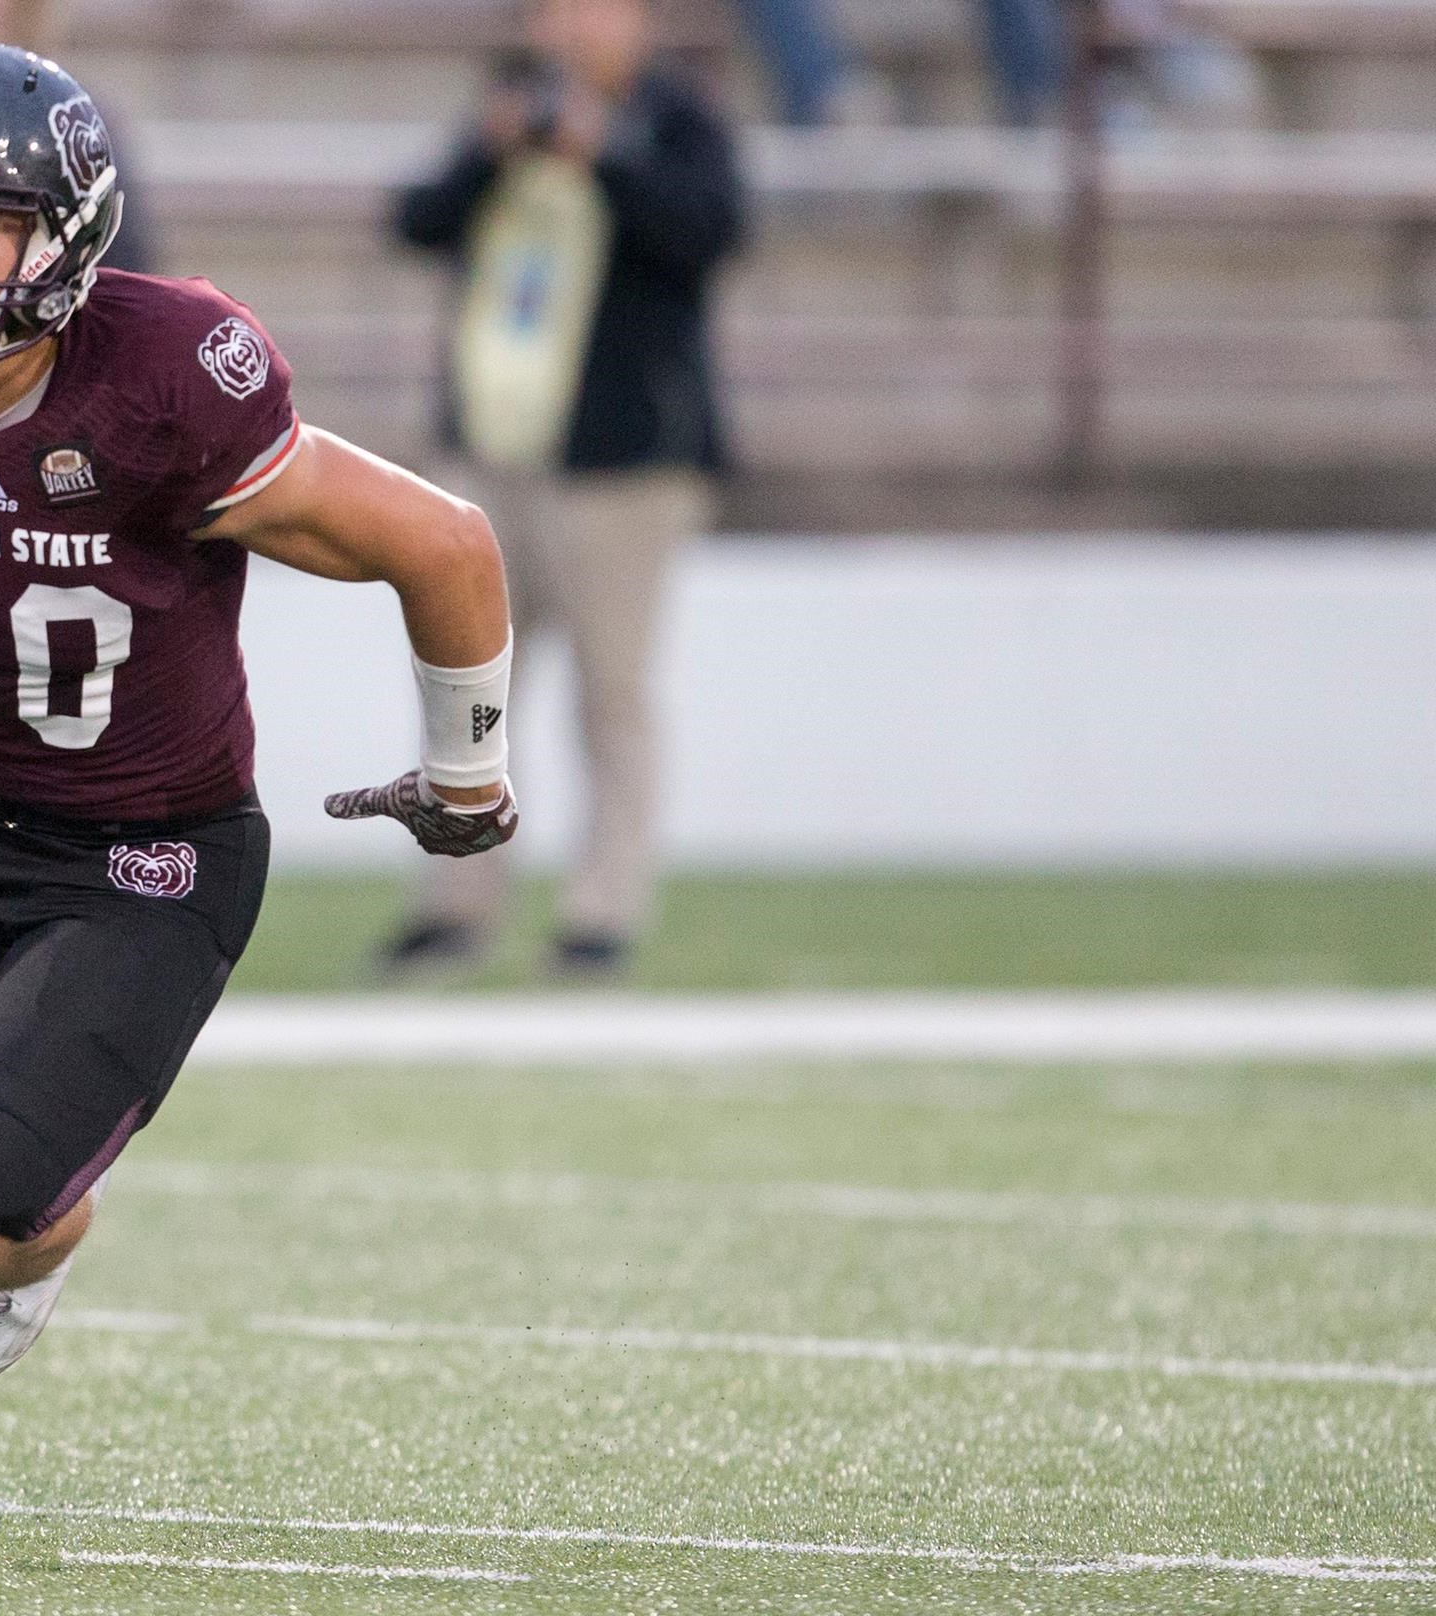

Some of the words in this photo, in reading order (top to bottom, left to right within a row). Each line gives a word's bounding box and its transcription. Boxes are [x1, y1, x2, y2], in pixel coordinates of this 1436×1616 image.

[19, 251, 54, 284] ddell
[40, 462, 96, 495] VALLEY
[11, 528, 113, 567] STATE
